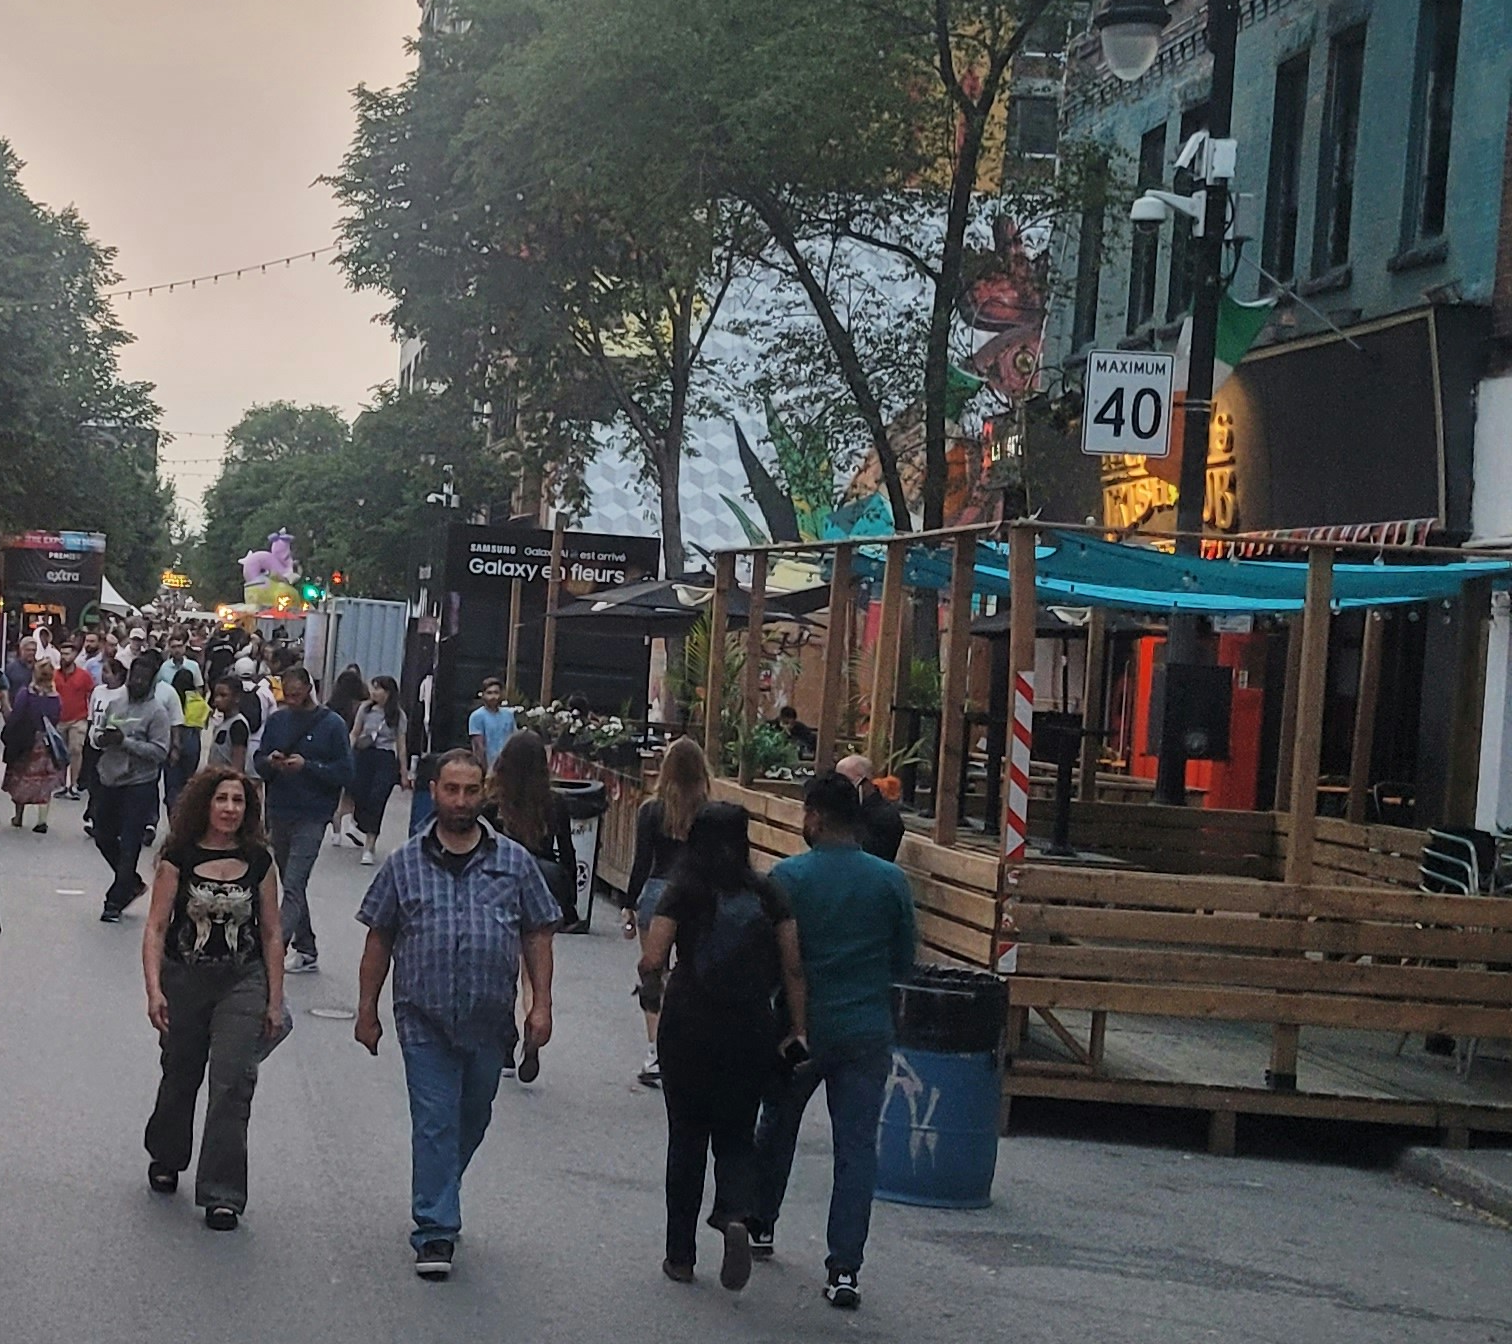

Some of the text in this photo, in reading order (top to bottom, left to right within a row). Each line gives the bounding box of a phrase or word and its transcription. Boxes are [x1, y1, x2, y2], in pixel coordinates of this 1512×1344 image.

[1096, 359, 1166, 376] MAXIMUM
[1093, 387, 1162, 439] 40
[470, 543, 517, 555] SAMSUNG
[524, 547, 553, 557] Galax
[580, 549, 596, 560] est
[597, 552, 627, 562] arrivé
[47, 569, 80, 583] extra
[469, 558, 538, 582] Galaxy
[571, 563, 625, 584] fleurs
